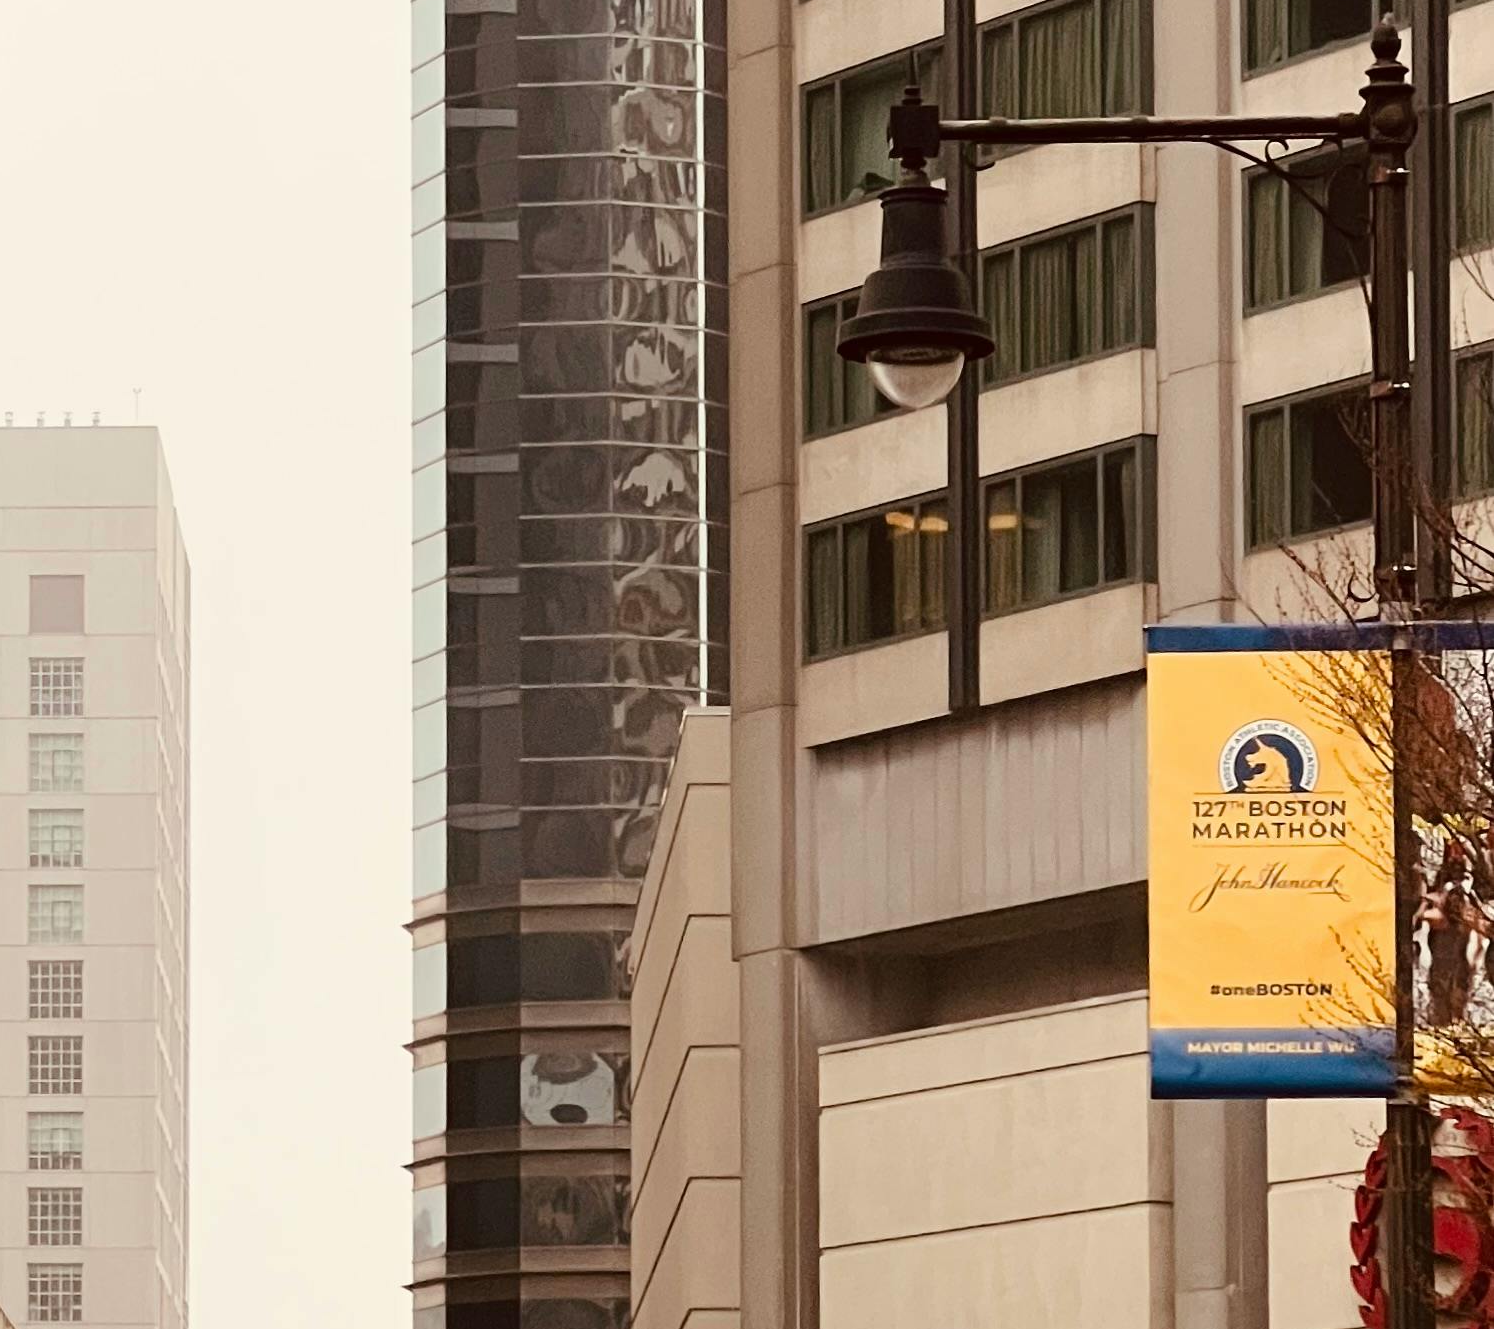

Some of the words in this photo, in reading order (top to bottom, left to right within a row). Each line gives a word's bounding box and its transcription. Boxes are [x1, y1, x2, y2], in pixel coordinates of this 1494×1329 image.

[1222, 745, 1236, 788] BOSTON
[1234, 722, 1280, 745] ATHLETIC
[1281, 725, 1316, 788] ASSOCIATION
[1192, 800, 1245, 818] 127TH
[1249, 800, 1347, 817] BOSTON
[1192, 821, 1347, 839] MARATHON
[1188, 862, 1254, 913] John
[1253, 860, 1351, 903] Hancock
[1210, 983, 1334, 997] #oneBOSTON
[1187, 1041, 1244, 1054] MAYOR
[1247, 1041, 1324, 1054] MICHELLE
